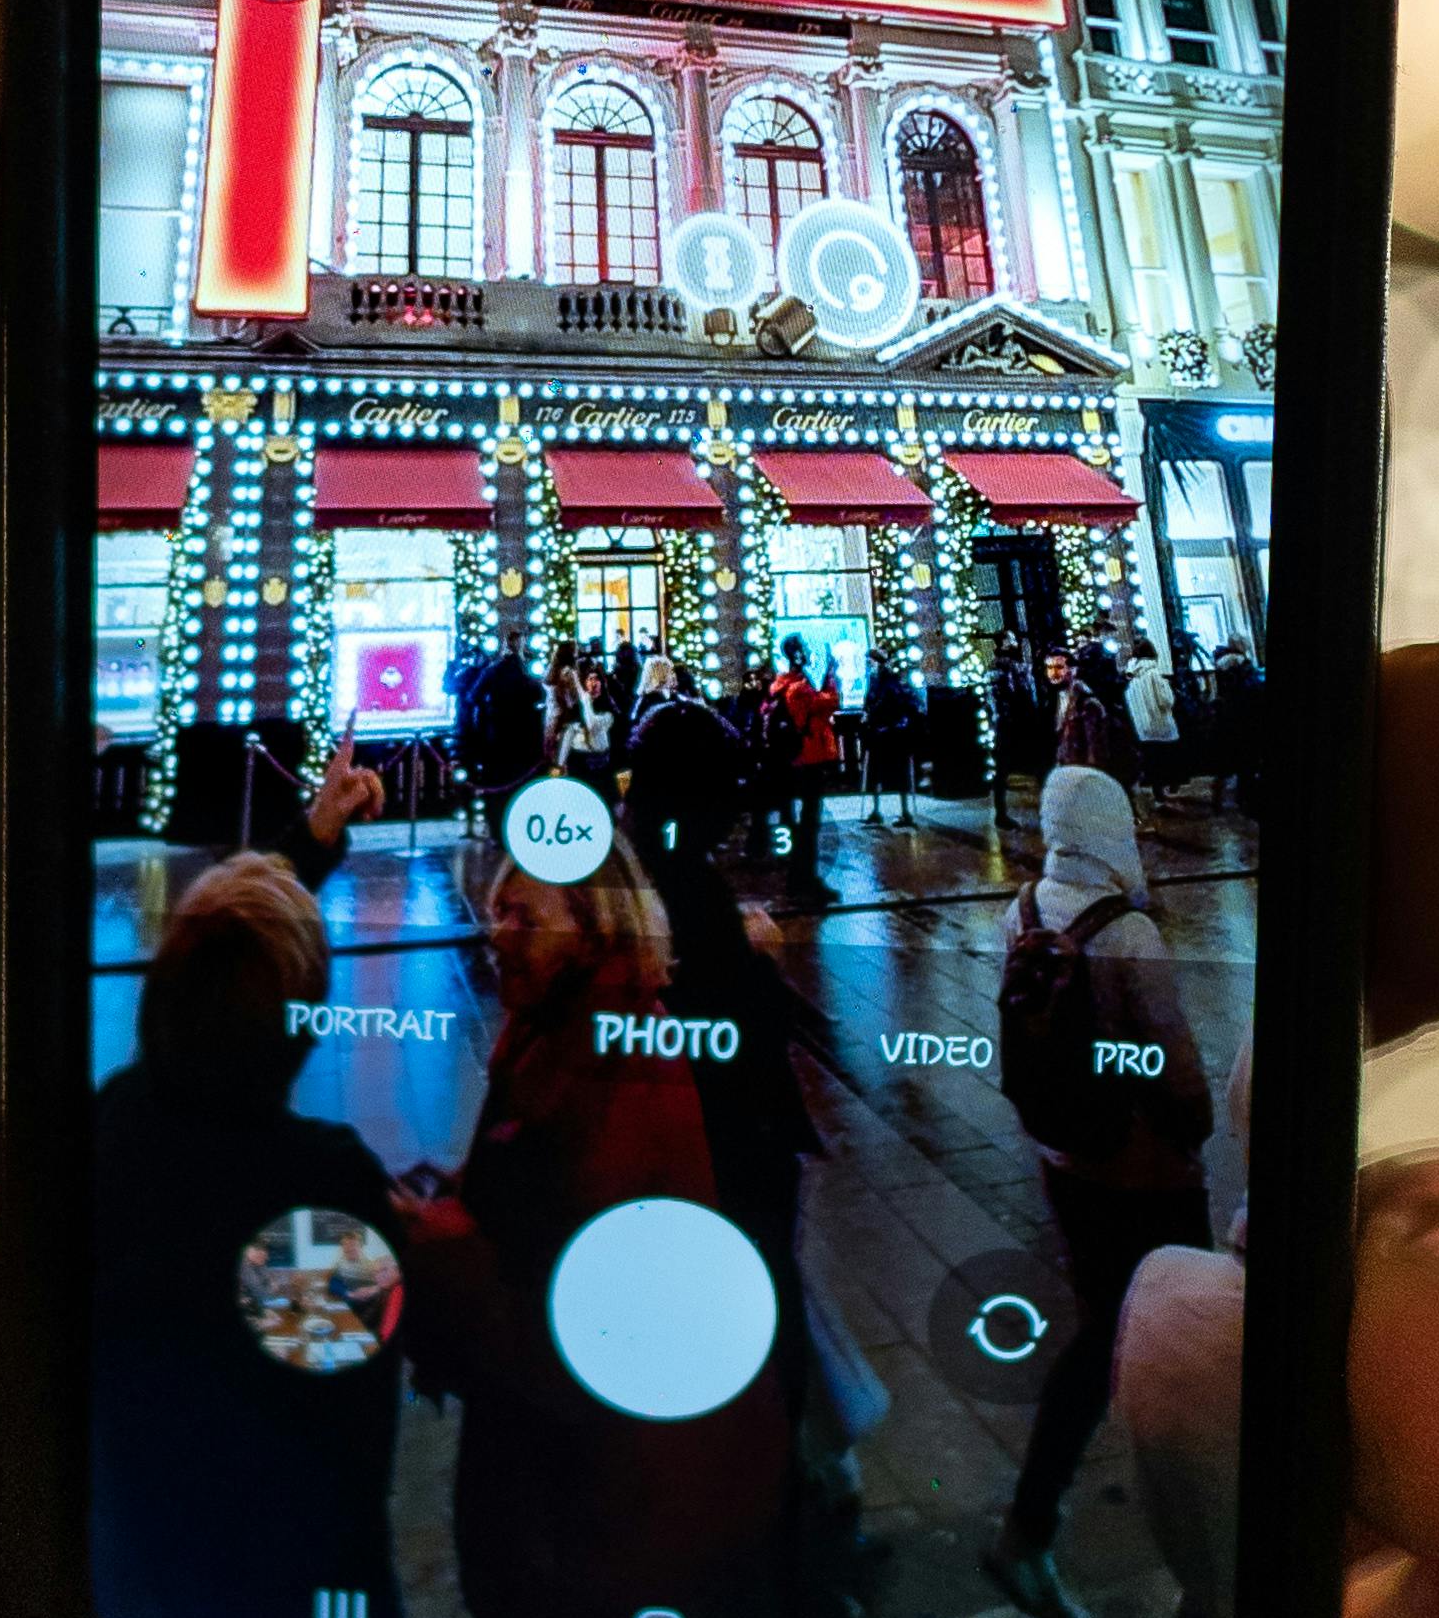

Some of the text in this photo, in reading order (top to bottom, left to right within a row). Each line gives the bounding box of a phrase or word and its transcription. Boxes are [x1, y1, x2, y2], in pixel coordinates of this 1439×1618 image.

[99, 394, 177, 420] artier
[350, 397, 449, 426] Cartier
[536, 407, 564, 422] 176
[570, 402, 661, 429] Cartier
[773, 407, 855, 433] Cartier
[963, 409, 1040, 432] Cartier
[526, 814, 793, 855] 0.6x 1 3
[286, 1002, 1165, 1077] PORTRAIT PHOTO VIDEO PRO
